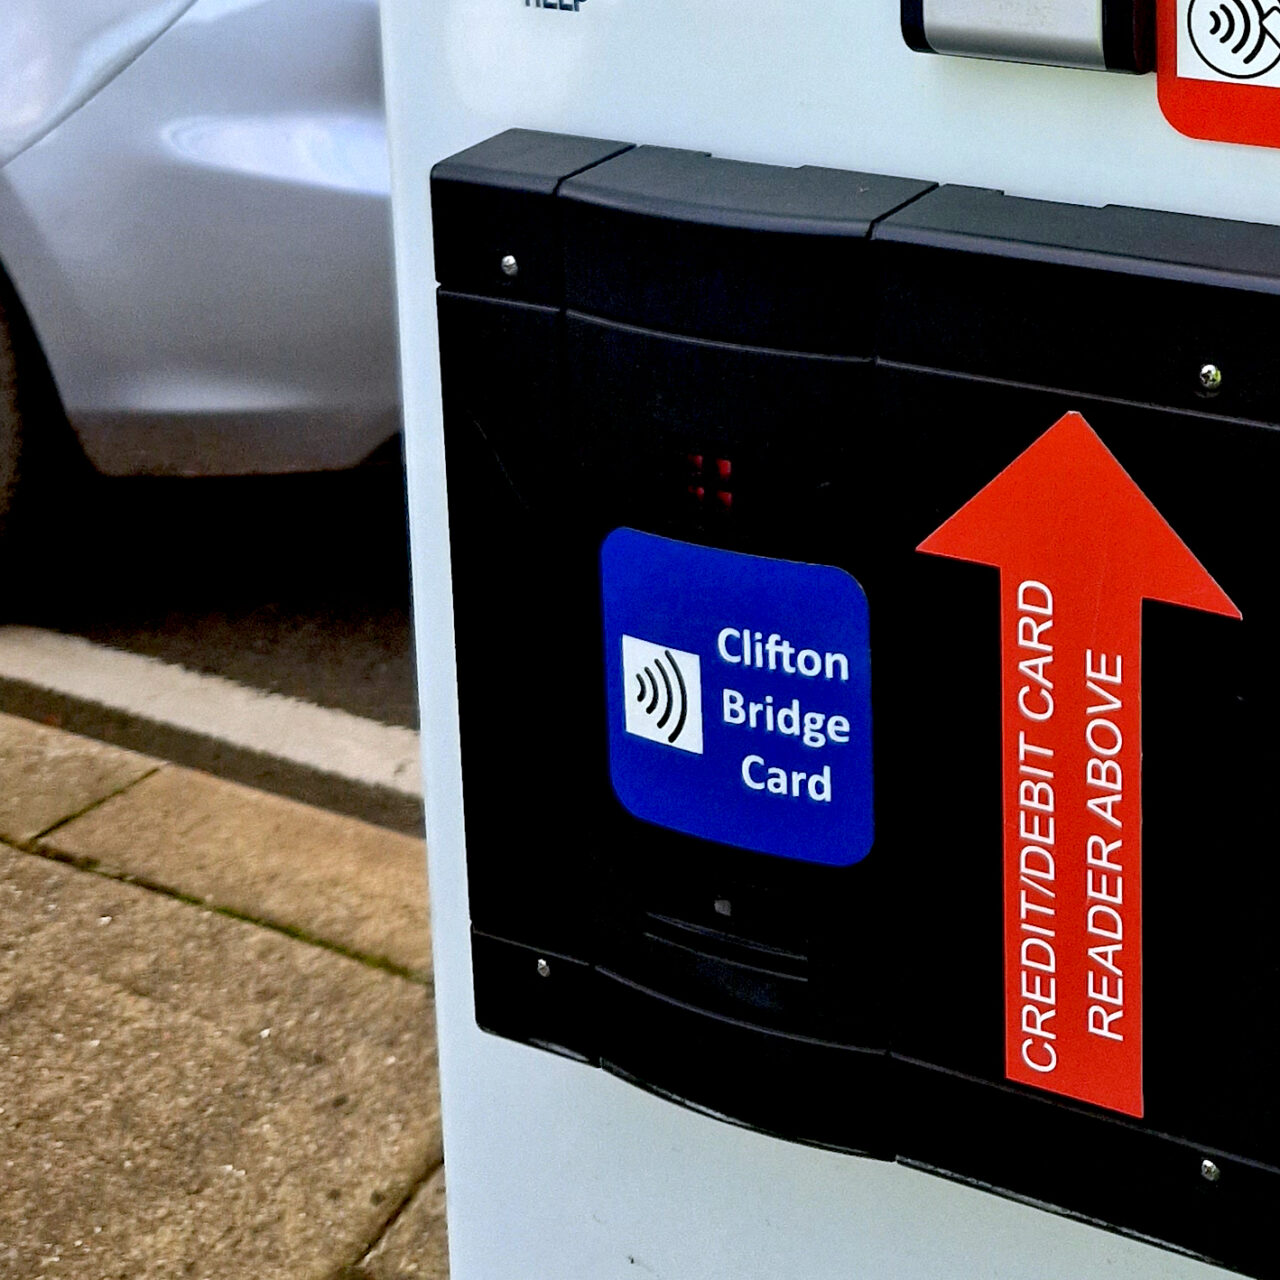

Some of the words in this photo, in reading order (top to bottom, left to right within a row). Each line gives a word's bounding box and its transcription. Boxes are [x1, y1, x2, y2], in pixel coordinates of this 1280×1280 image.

[717, 626, 849, 681] Clifton
[723, 688, 850, 748] Bridge
[1017, 580, 1054, 721] CARD
[742, 754, 832, 803] Card
[1085, 649, 1122, 829] ABOVE
[1018, 731, 1057, 1073] CREDIT/DEBIT
[1087, 834, 1124, 1042] READER
